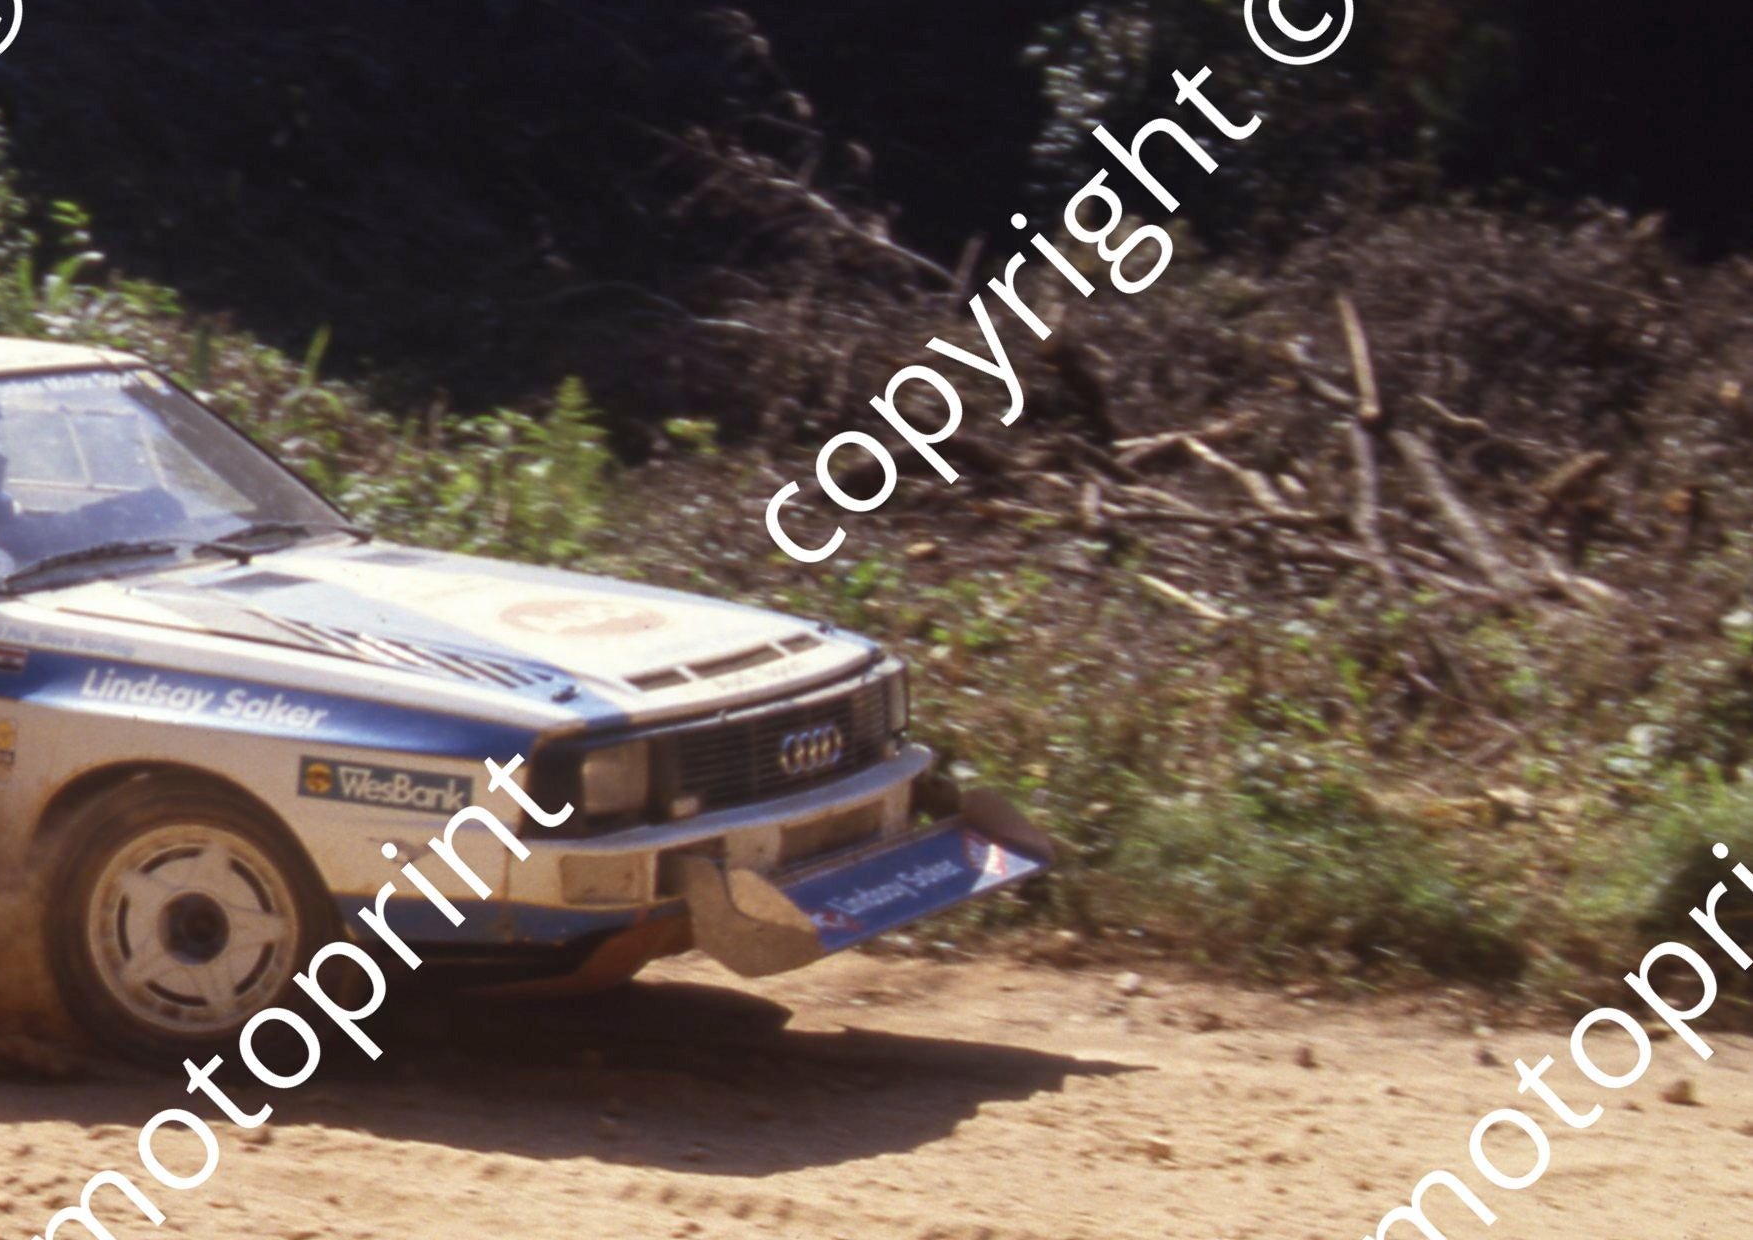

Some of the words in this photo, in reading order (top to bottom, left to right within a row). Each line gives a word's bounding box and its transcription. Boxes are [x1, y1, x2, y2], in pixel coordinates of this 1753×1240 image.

[81, 667, 211, 715] Lindsay
[219, 689, 329, 730] Saker
[336, 765, 467, 813] WesBank
